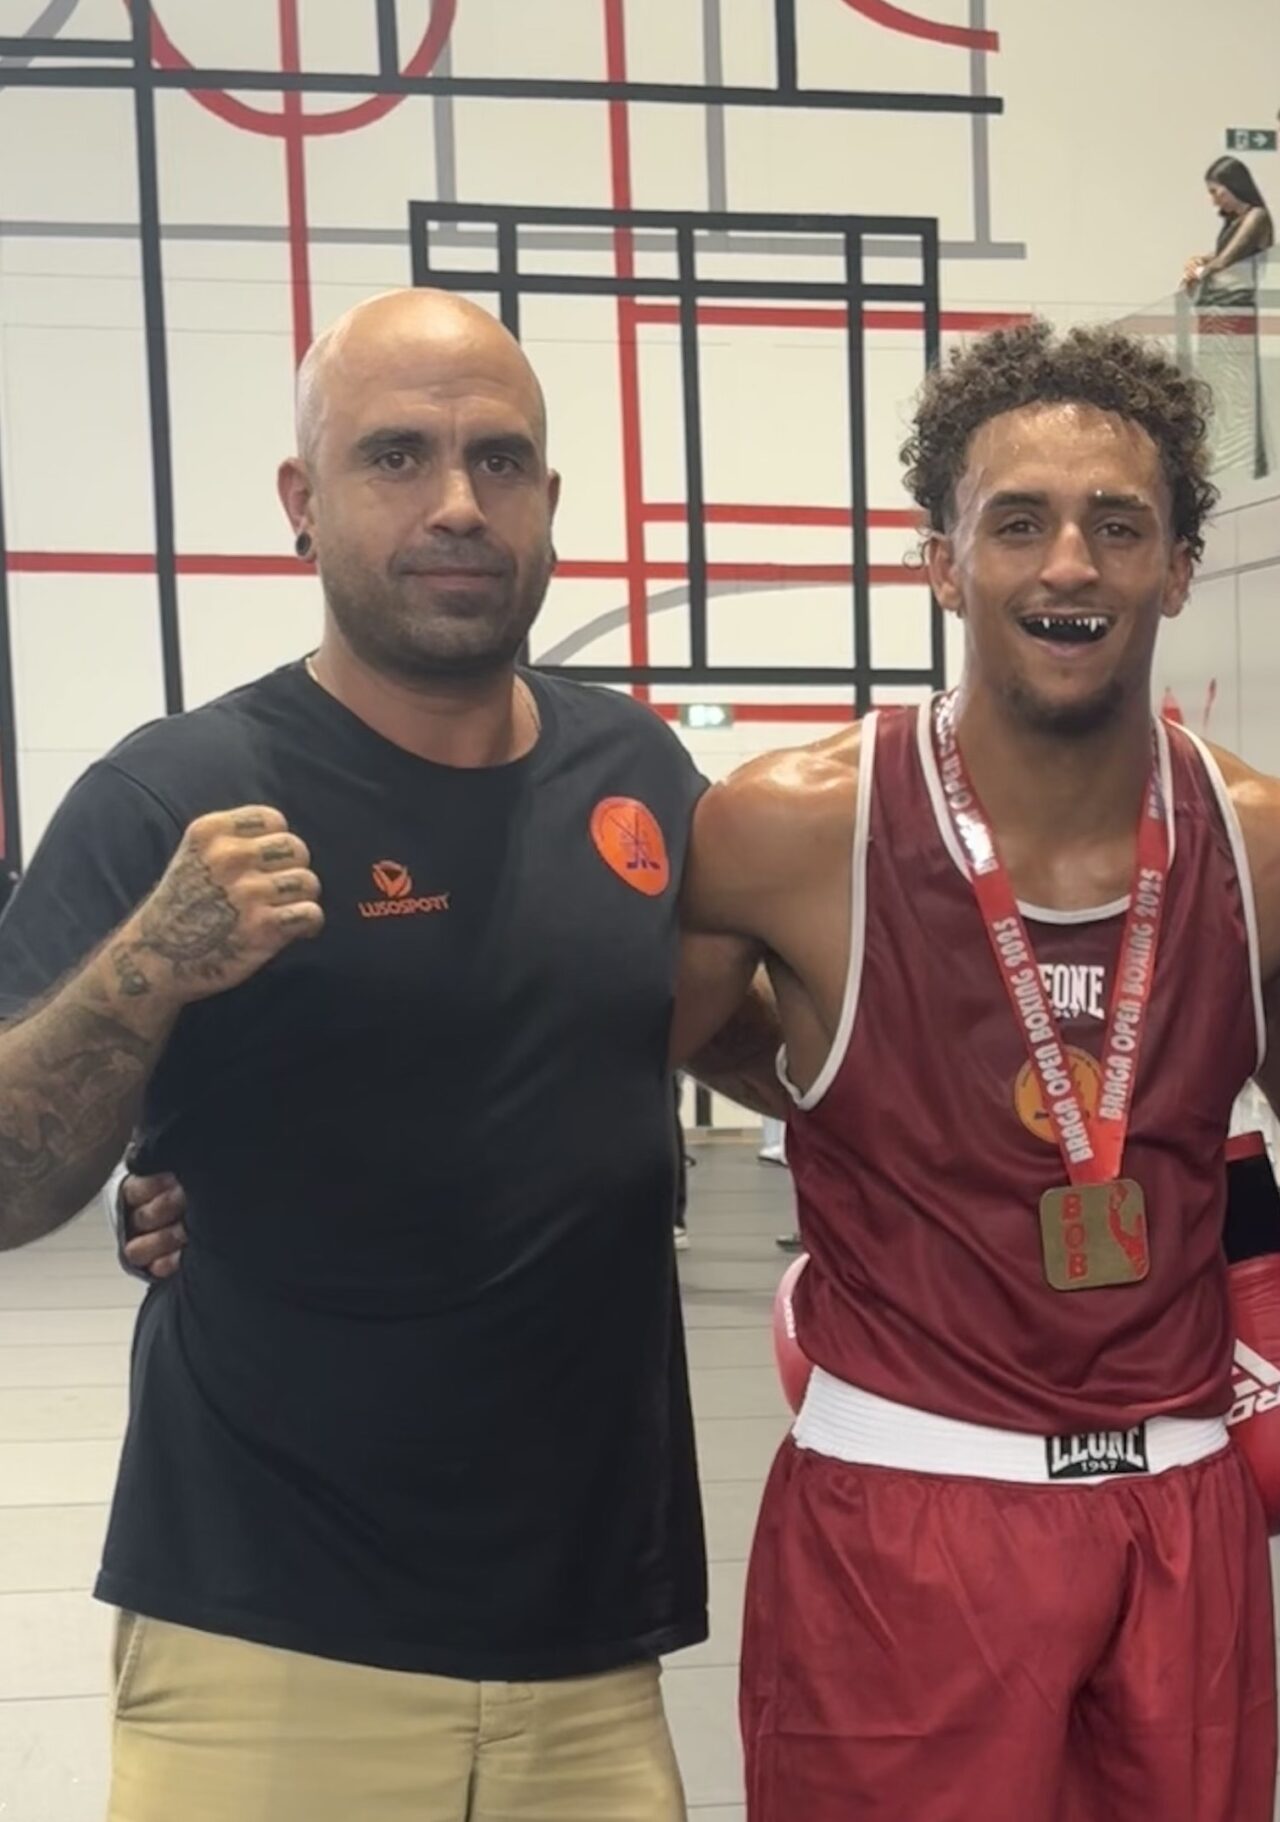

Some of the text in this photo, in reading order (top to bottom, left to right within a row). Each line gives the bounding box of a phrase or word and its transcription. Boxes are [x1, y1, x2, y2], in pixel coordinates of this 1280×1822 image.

[358, 893, 451, 918] LUSOSPORT
[993, 917, 1028, 968] 2025
[1010, 968, 1054, 1043] BOXING
[1037, 964, 1105, 1020] EONE
[1100, 868, 1163, 1121] BRAGA OPEN BOXING 2025
[1034, 1043, 1071, 1096] OPEN
[1052, 1097, 1095, 1164] BRAGA
[1051, 1429, 1144, 1473] LEONE
[1080, 1460, 1118, 1473] 1947
